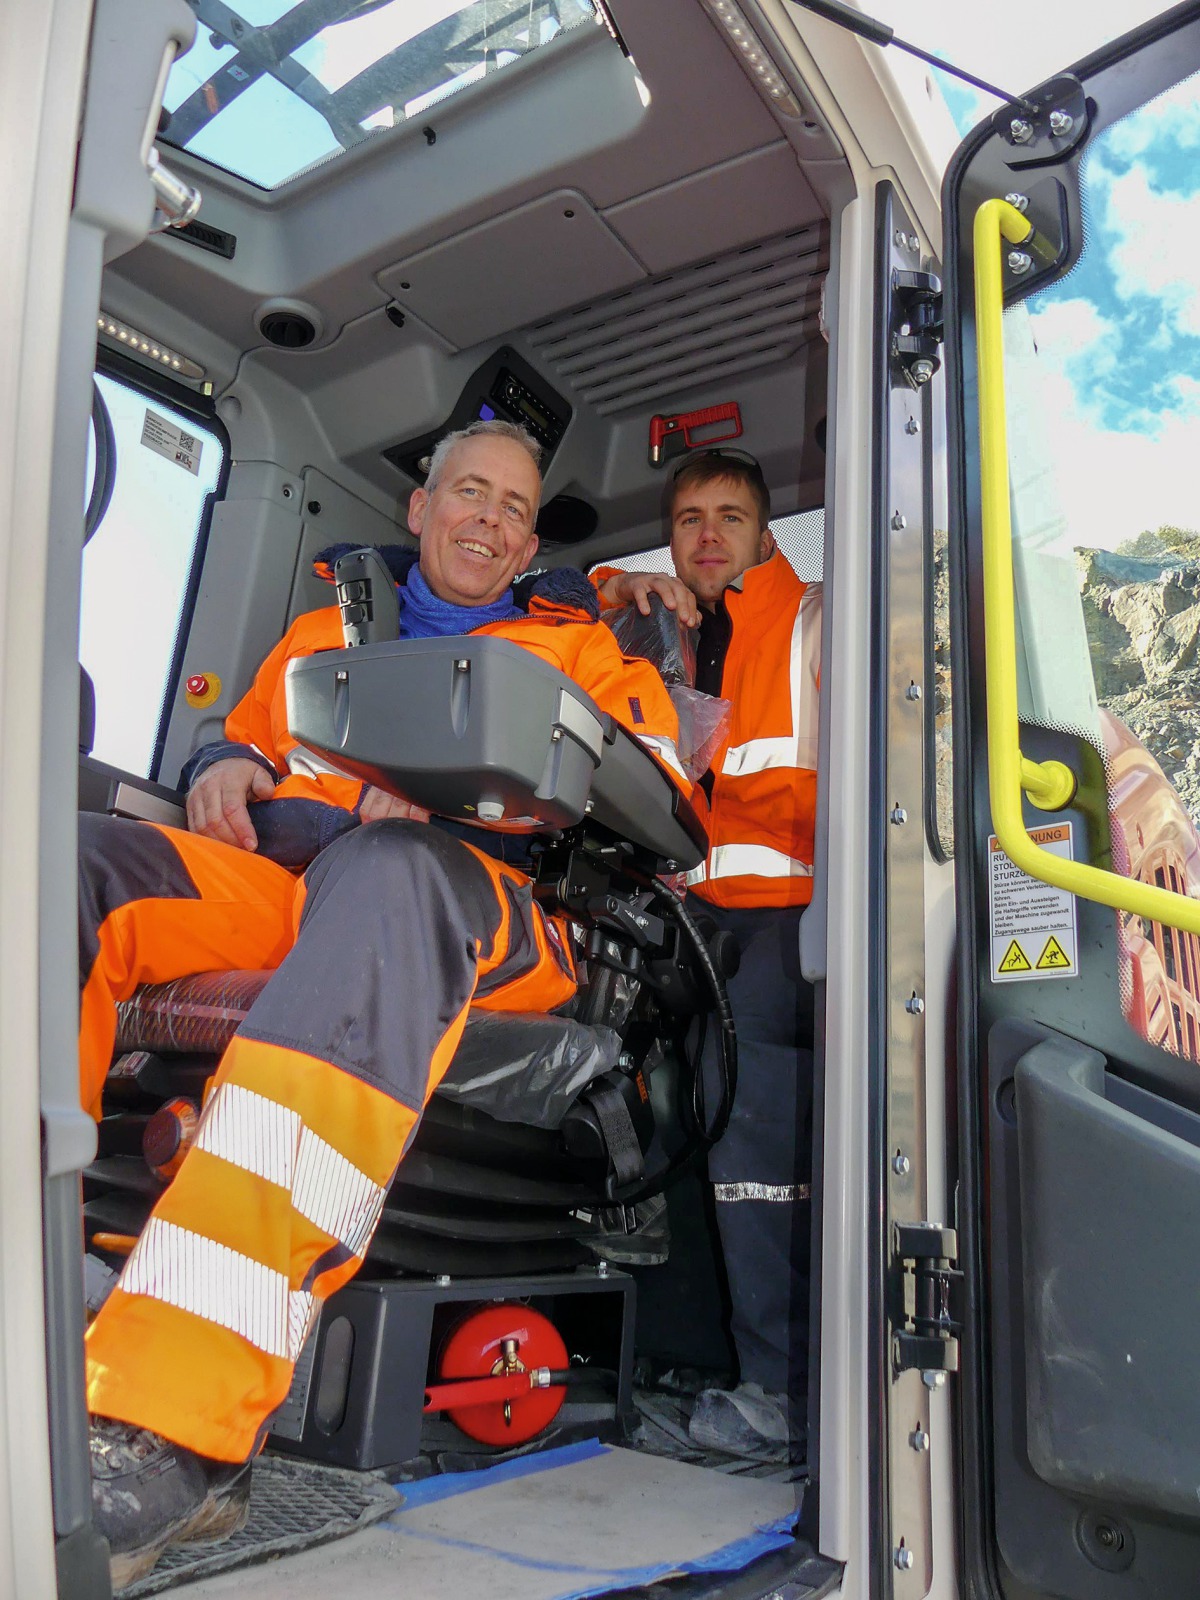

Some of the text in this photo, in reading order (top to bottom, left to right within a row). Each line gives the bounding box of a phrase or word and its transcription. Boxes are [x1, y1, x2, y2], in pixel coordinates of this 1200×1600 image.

[1031, 830, 1062, 842] NUNG
[993, 854, 1009, 862] RUT
[993, 862, 1018, 872] STOL
[993, 870, 1028, 881] STURZG
[1001, 886, 1025, 894] schweren
[1030, 895, 1060, 904] Aussteigen
[1003, 906, 1029, 914] Haltegriffe
[1030, 902, 1059, 910] verwenden
[1015, 911, 1039, 919] Maschine
[1040, 908, 1070, 917] zugewandt
[994, 927, 1030, 936] Zugangswege
